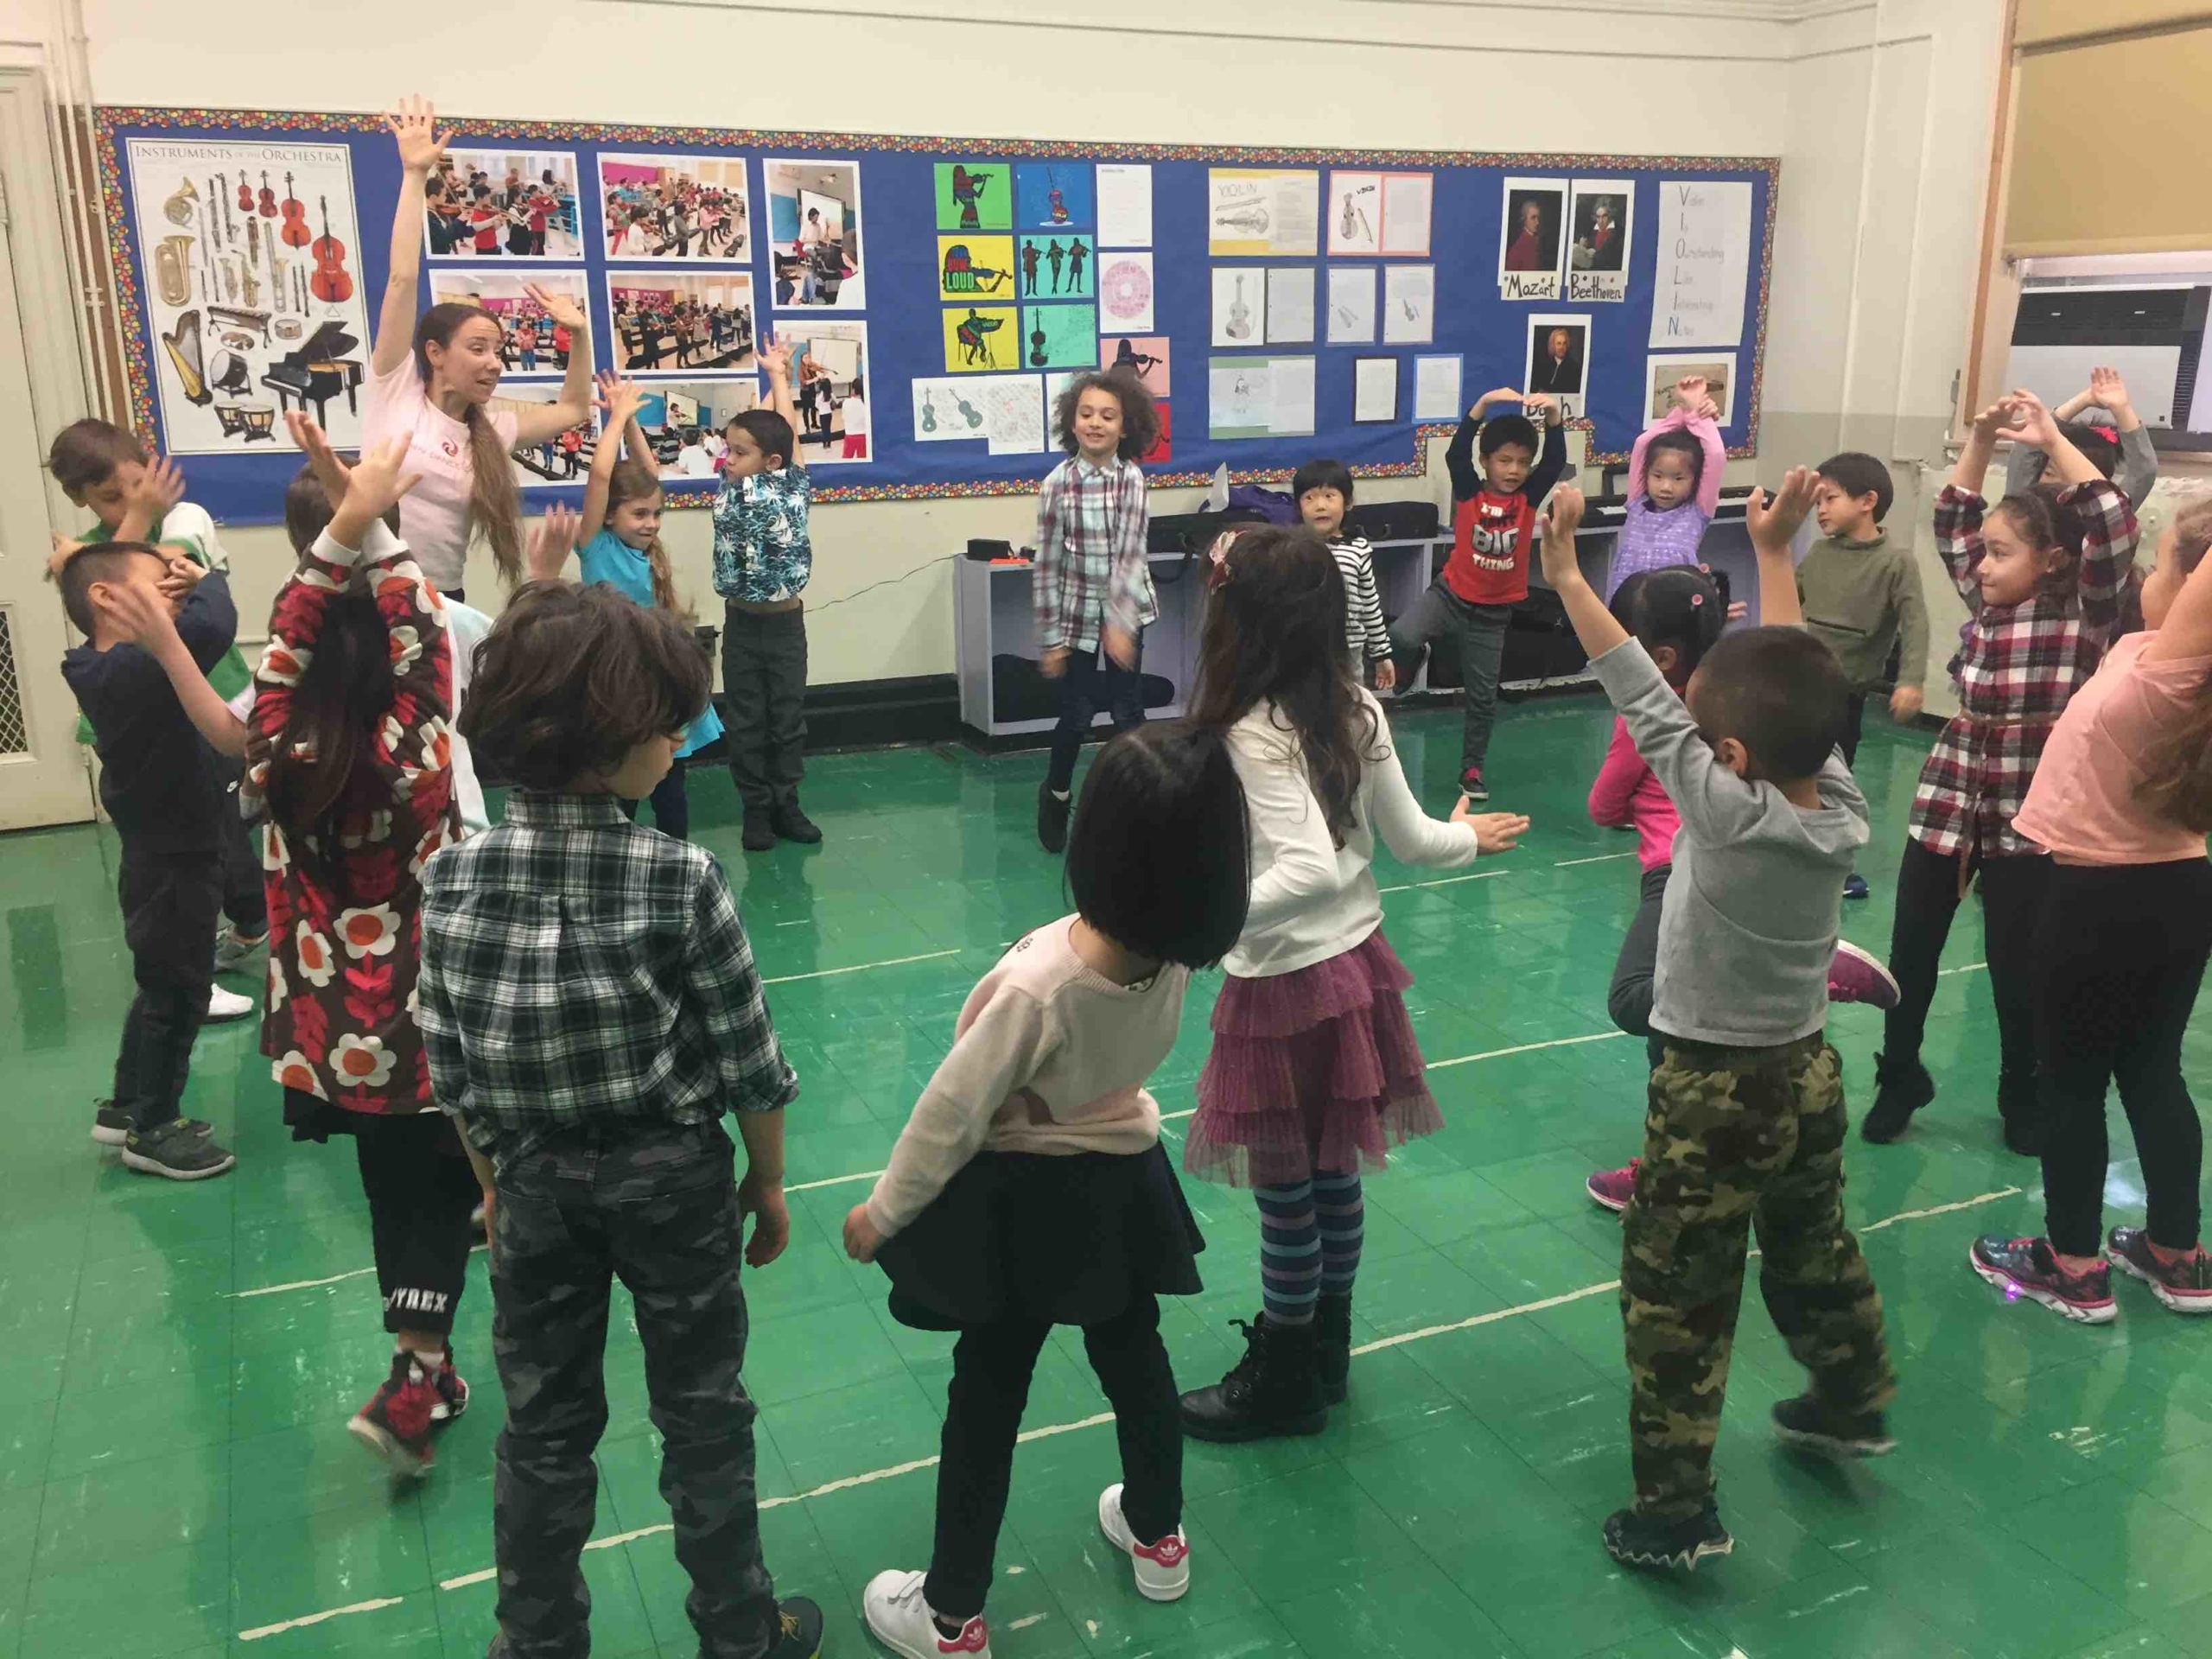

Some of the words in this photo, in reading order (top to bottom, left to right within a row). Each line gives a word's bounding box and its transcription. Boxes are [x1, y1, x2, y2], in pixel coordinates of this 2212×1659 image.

[136, 145, 233, 160] INSTRUMENTS
[262, 148, 342, 163] ORCHESTRA
[1217, 183, 1258, 197] VIOLIN
[946, 271, 975, 289] LOUD
[1507, 273, 1555, 298] Mozart
[1571, 273, 1622, 300] Beethoven
[1527, 396, 1573, 420] Bah
[1471, 553, 1515, 571] THING
